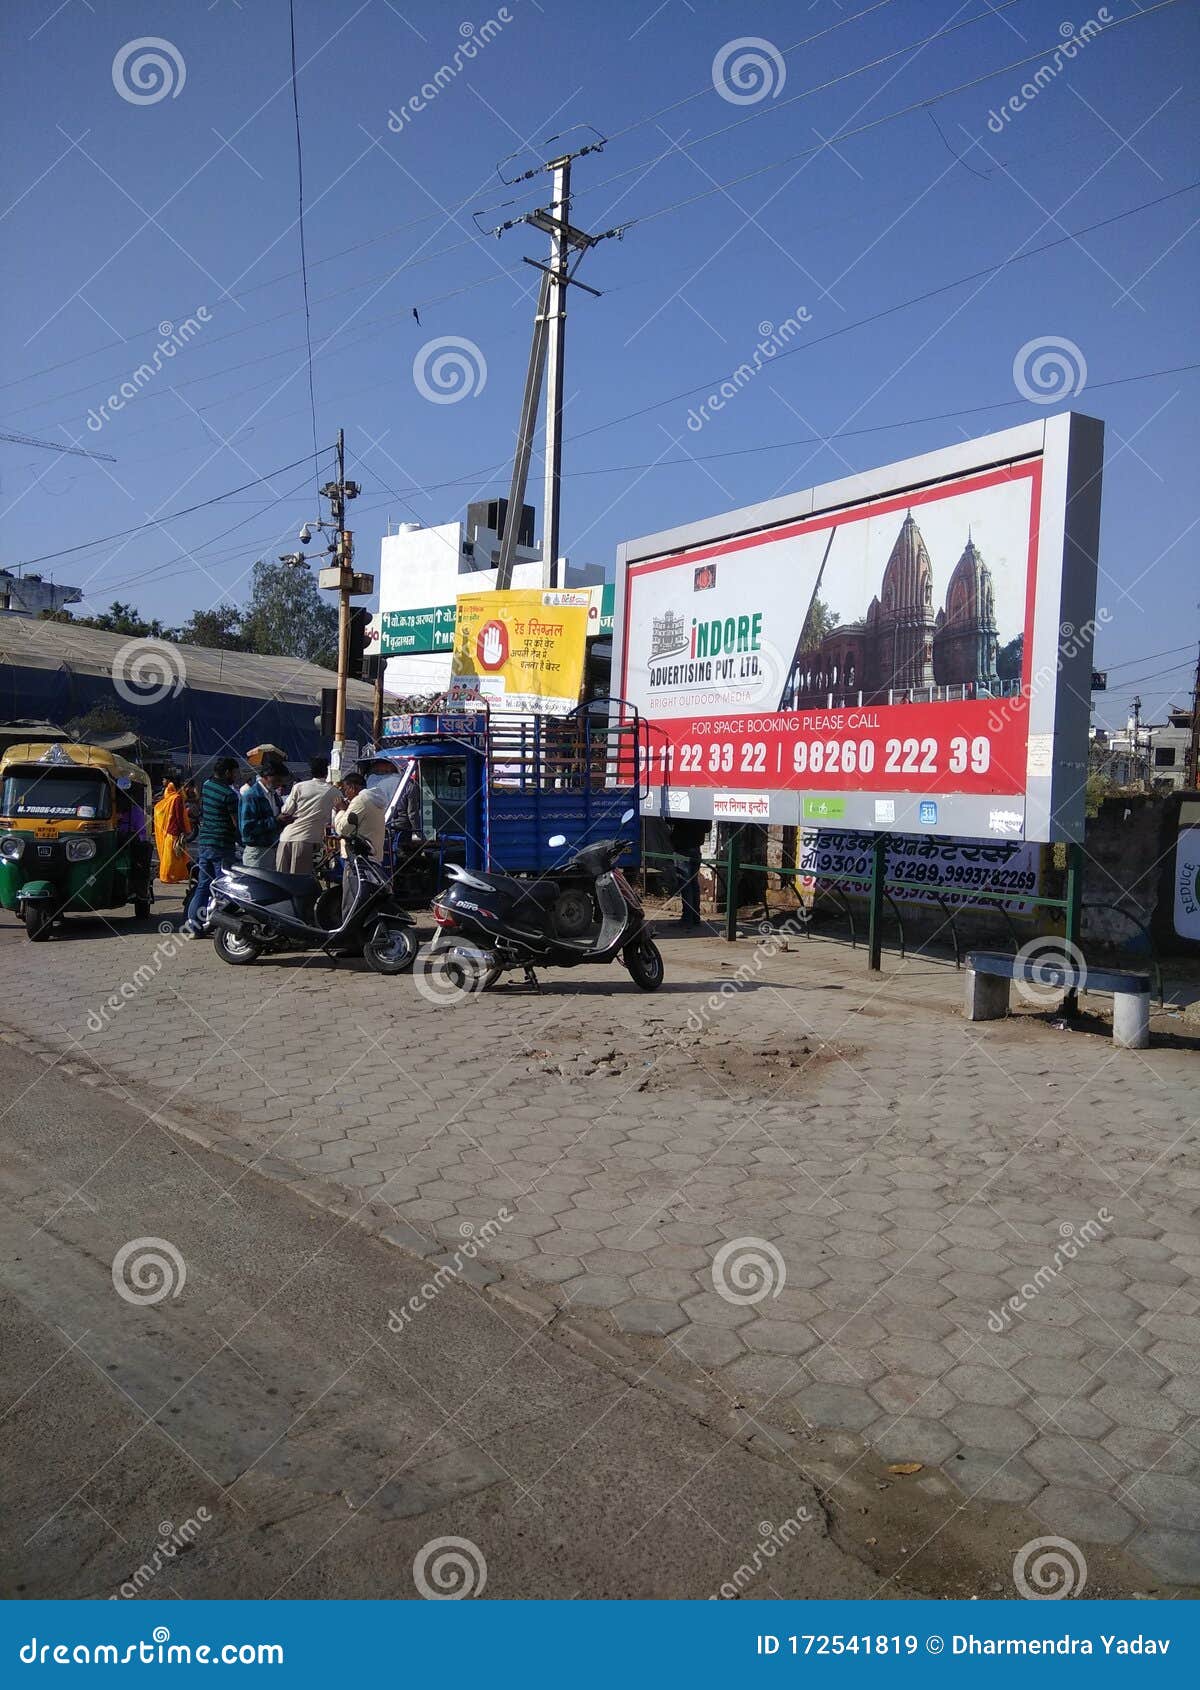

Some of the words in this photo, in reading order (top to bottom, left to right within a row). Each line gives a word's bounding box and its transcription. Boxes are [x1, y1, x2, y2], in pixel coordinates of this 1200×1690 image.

[514, 618, 525, 634] रेड
[649, 661, 712, 687] ADVERTISING
[715, 659, 736, 681] PVT.
[740, 655, 762, 678] LTD.
[650, 697, 677, 709] BRIGHT
[679, 694, 720, 706] OUTDOOR
[722, 691, 752, 704] MEDIA
[691, 722, 711, 735] FOR
[713, 720, 744, 735] SPACE
[747, 717, 800, 733] BOOKING
[803, 715, 844, 731] PLEASE
[847, 713, 880, 729] CALL
[679, 743, 703, 773] 22
[708, 743, 734, 773] 33
[740, 742, 767, 773] 22
[793, 739, 875, 773] 98260
[884, 738, 938, 773] 222
[949, 736, 991, 774] 39
[714, 800, 728, 812] नगर
[729, 797, 746, 813] निगम
[1180, 862, 1197, 914] REDUCE
